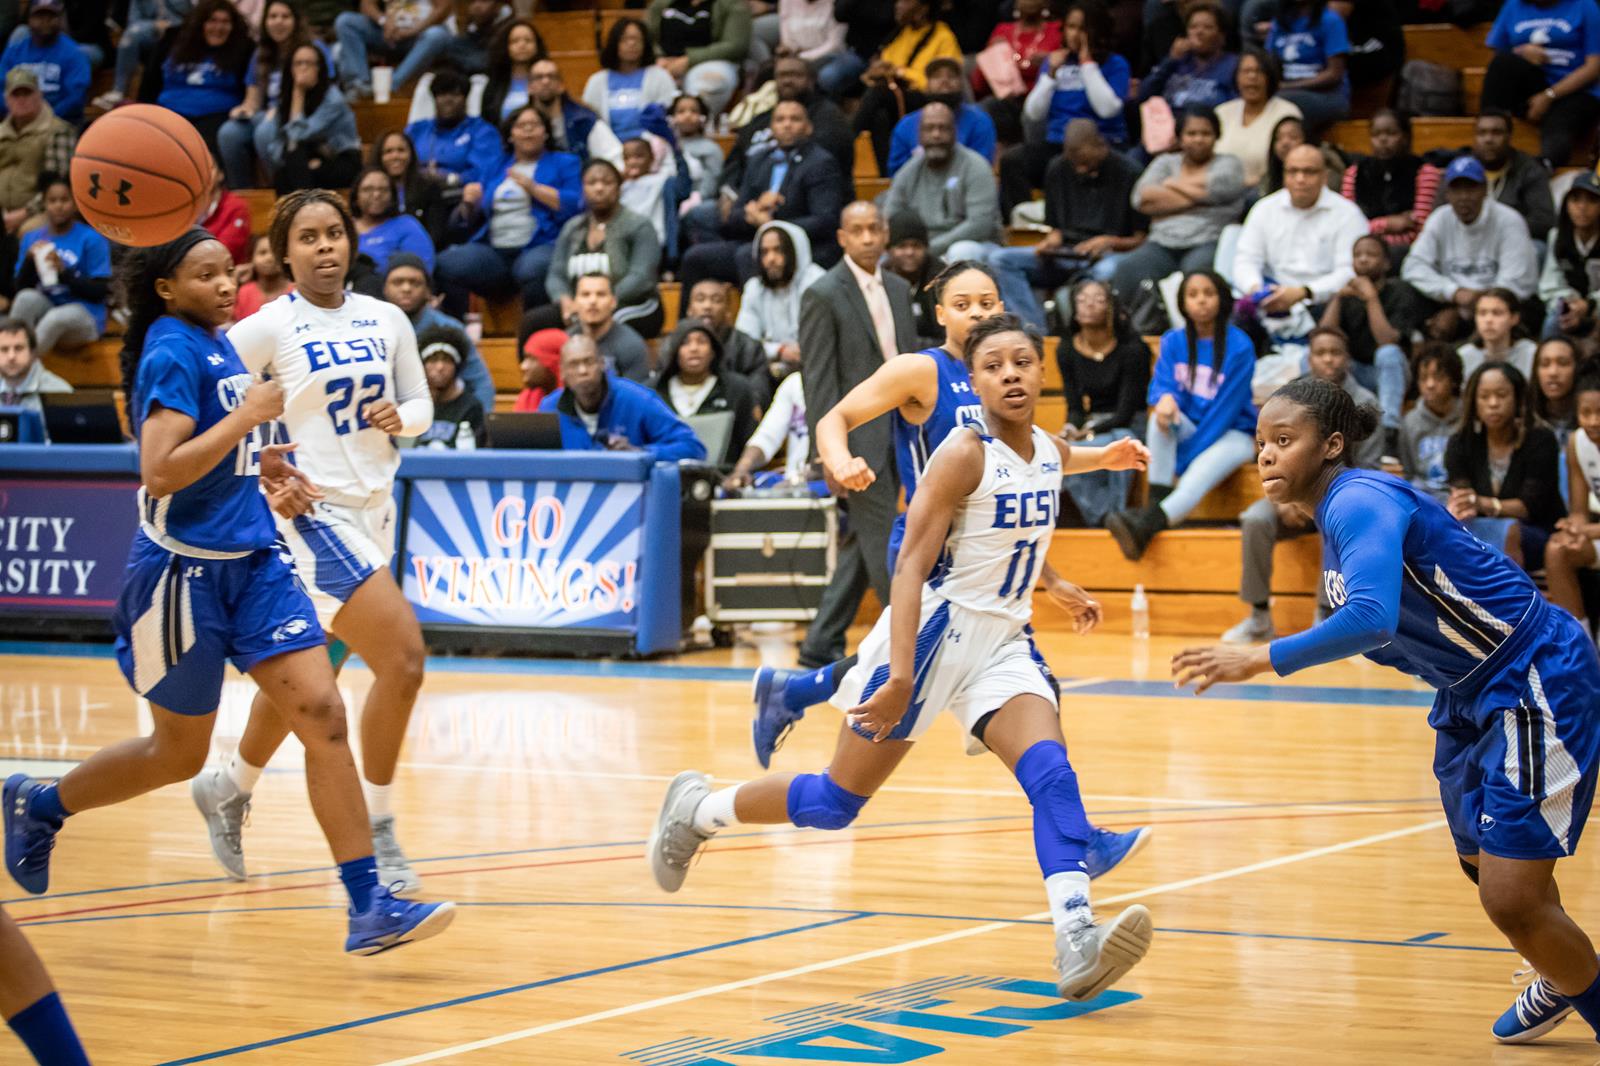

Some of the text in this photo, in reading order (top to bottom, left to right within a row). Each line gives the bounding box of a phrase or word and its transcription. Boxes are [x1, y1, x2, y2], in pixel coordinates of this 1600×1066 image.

[301, 337, 386, 373] ECSU
[325, 373, 386, 436] 22
[0, 516, 74, 552] ITY
[492, 494, 566, 548] GO
[0, 558, 96, 596] SITY
[411, 555, 637, 614] VIKINGS!
[998, 539, 1038, 600] 11
